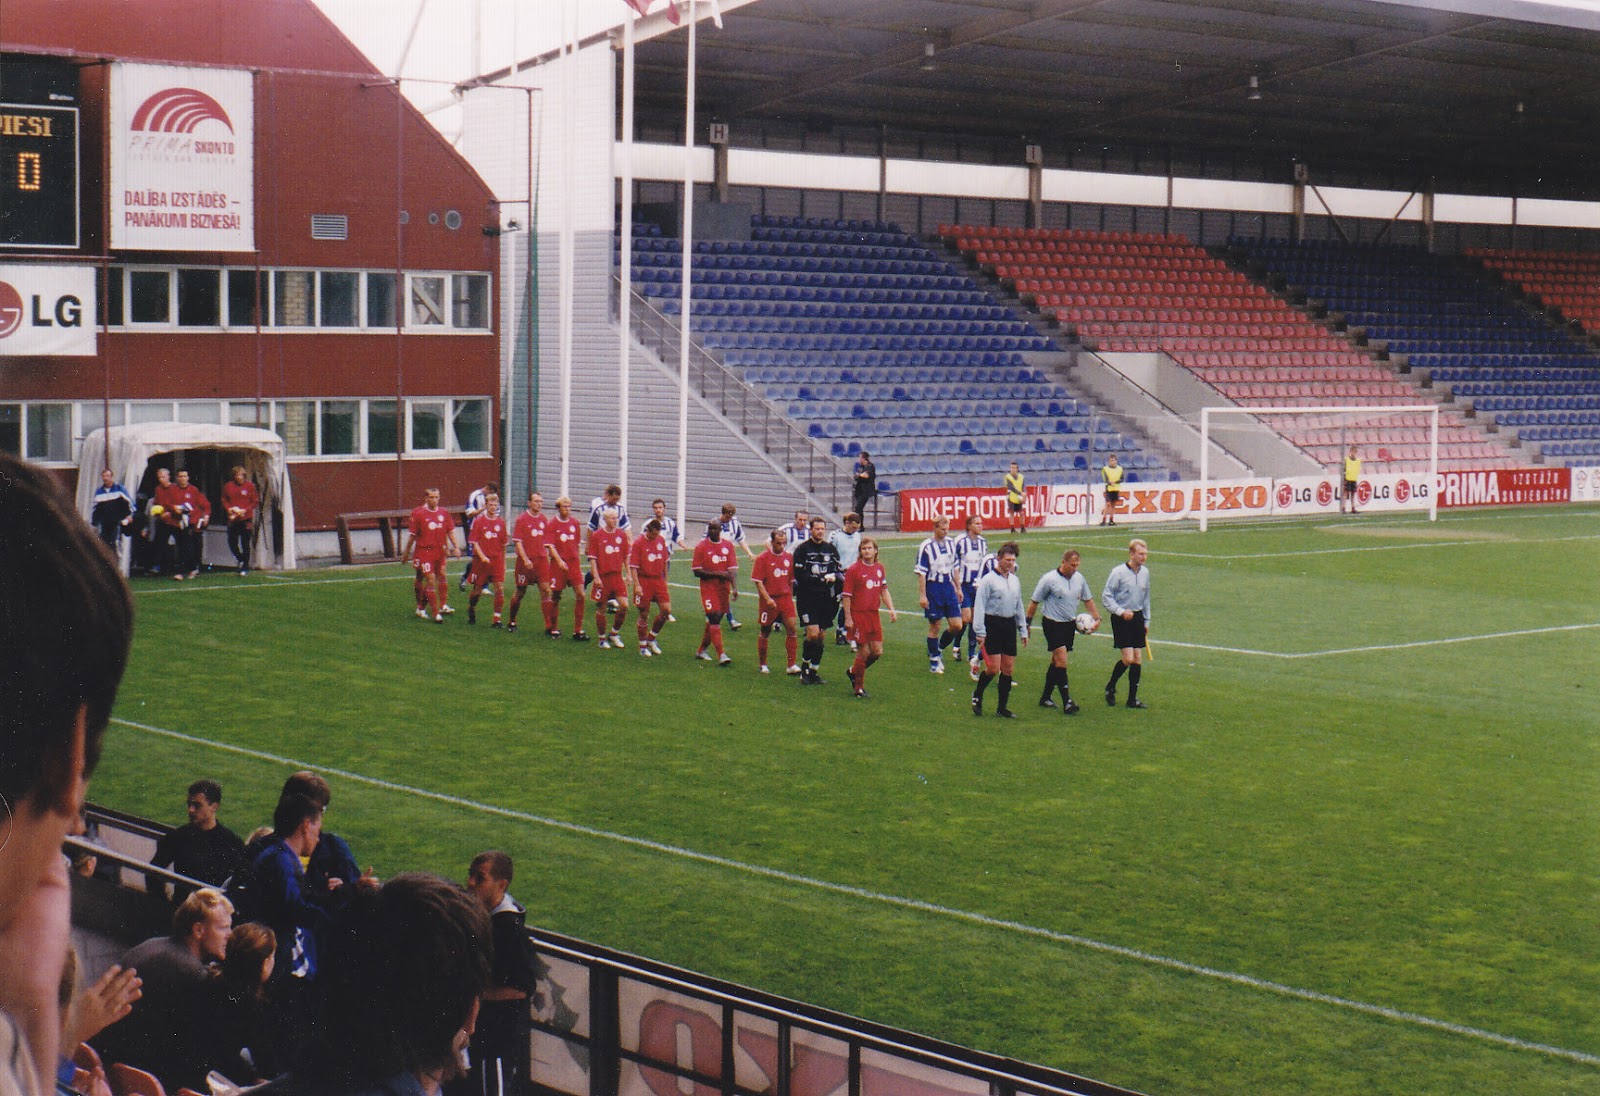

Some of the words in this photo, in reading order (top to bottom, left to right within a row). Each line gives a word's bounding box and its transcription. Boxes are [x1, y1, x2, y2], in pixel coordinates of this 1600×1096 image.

[0, 115, 53, 137] IESI
[714, 125, 724, 139] H
[195, 140, 235, 155] SKONTO
[19, 152, 40, 190] 0
[124, 189, 168, 206] DALĪBA
[171, 190, 227, 208] IZSTĀDĒS
[124, 210, 188, 228] PANĀKUMI
[32, 294, 82, 327] LG
[1190, 485, 1267, 511] EXO
[1295, 487, 1311, 502] LG
[1373, 485, 1389, 499] LG
[1412, 484, 1428, 498] LG
[1435, 472, 1500, 506] PRIMA
[1102, 489, 1184, 514] EXO
[421, 562, 431, 573] 10
[705, 599, 712, 611] 5
